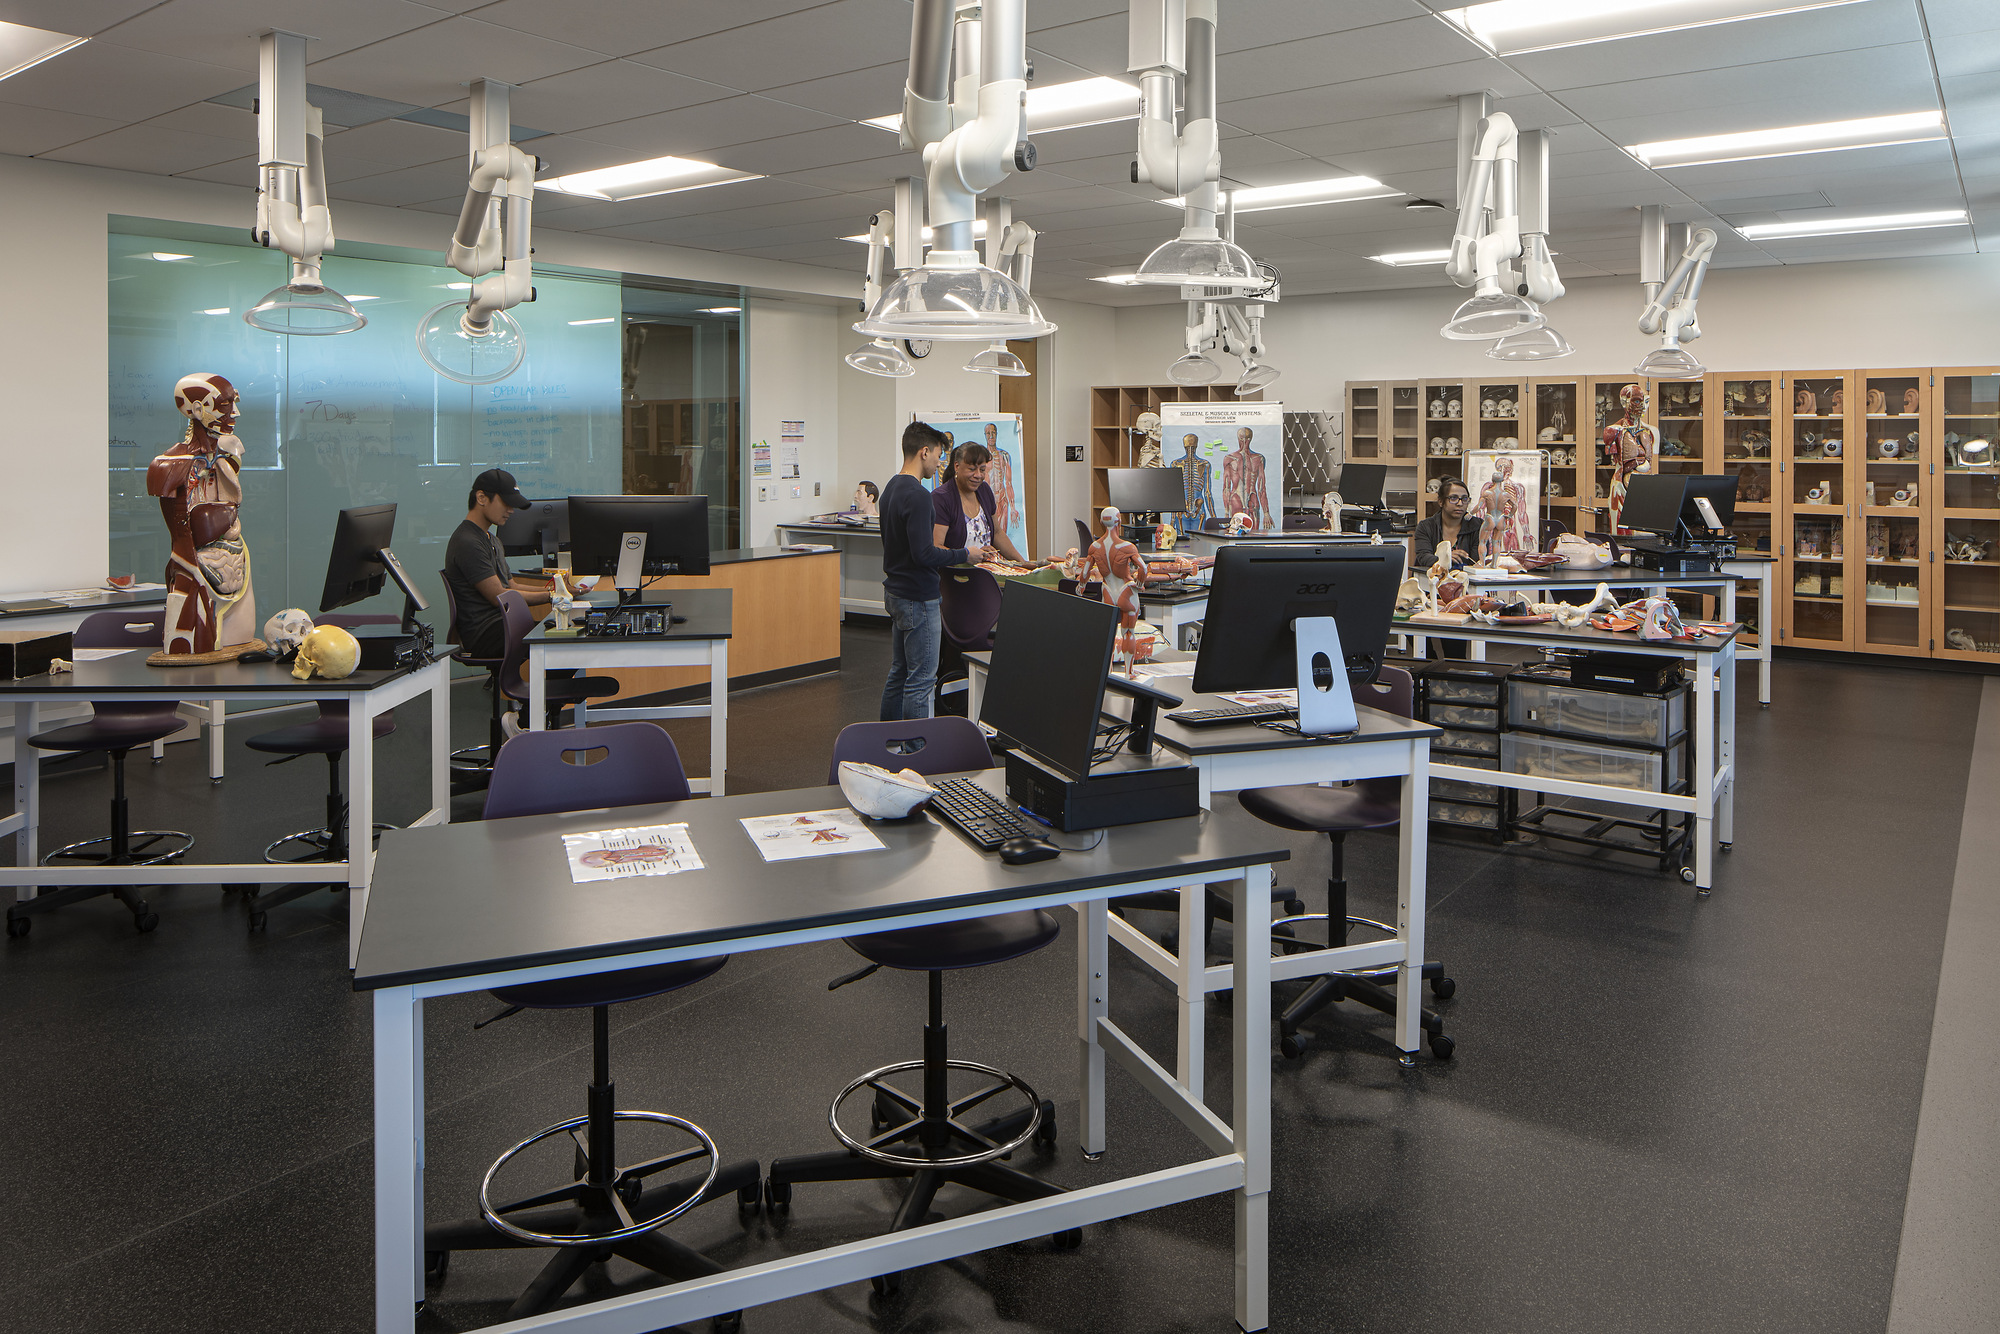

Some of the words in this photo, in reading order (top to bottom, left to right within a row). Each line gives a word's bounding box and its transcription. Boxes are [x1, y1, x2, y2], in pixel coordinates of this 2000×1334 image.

[493, 385, 519, 398] OPEN
[520, 386, 538, 397] LAB
[542, 384, 567, 396] RULES
[305, 400, 323, 420] 7
[323, 403, 357, 425] Days
[1296, 583, 1336, 594] acer
